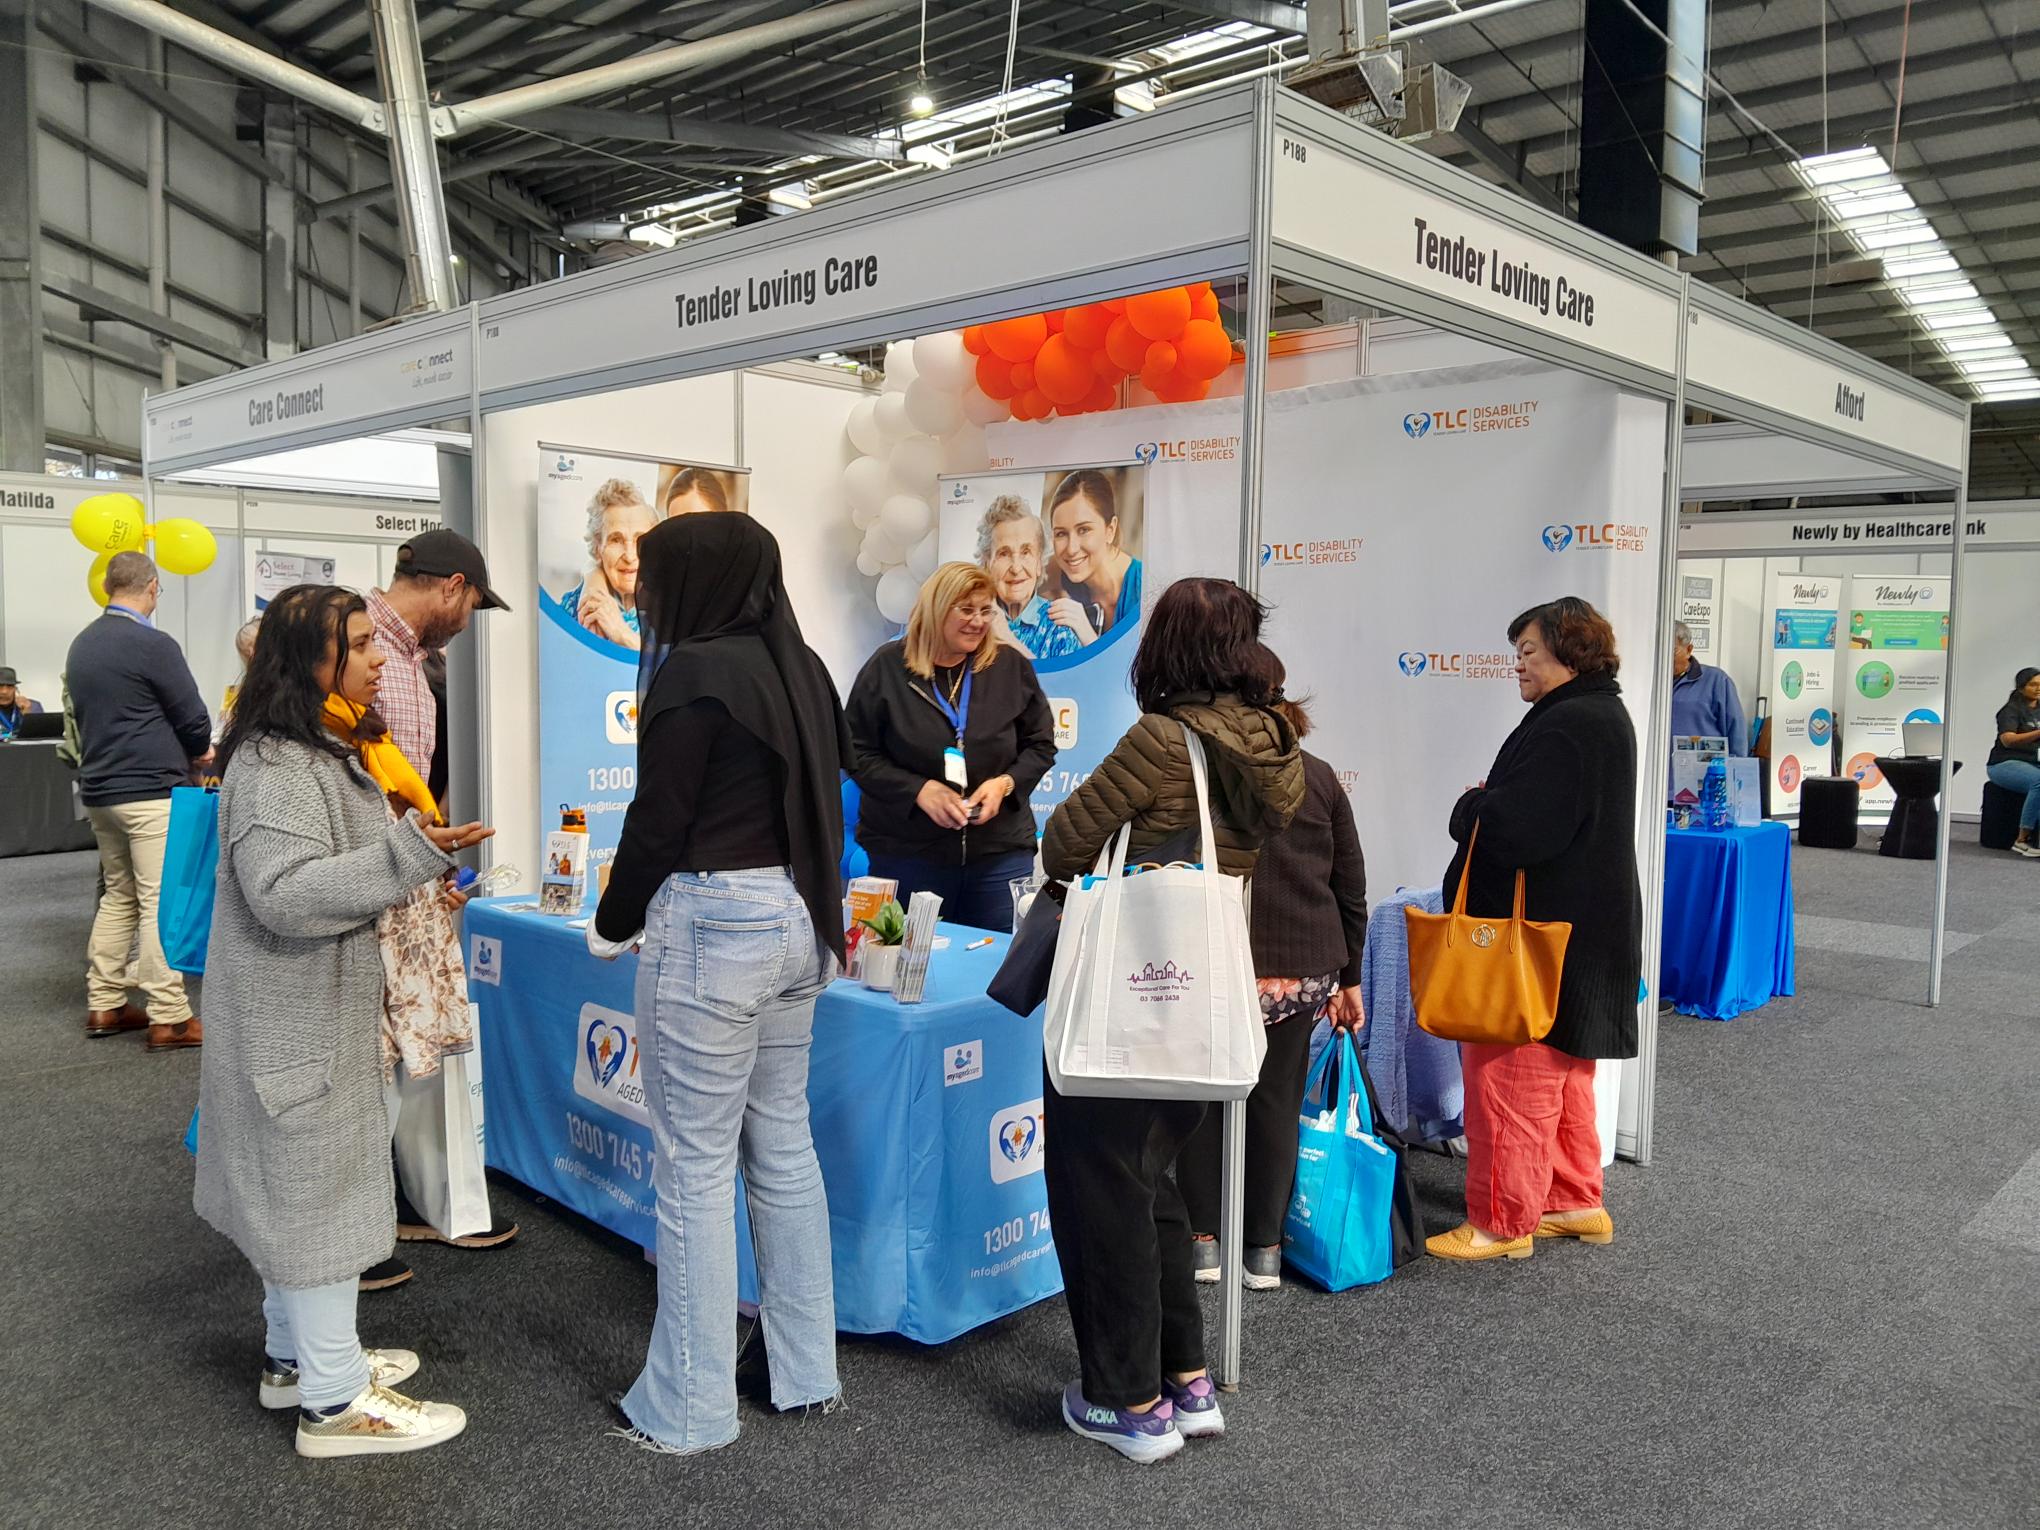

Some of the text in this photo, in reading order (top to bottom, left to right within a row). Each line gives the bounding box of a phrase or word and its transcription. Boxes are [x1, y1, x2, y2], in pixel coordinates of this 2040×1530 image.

[1283, 138, 1306, 163] P188
[1414, 217, 1594, 326] Tender Loving Care
[675, 255, 878, 328] Tender Loving Care
[248, 383, 324, 427] Care Connect
[1473, 400, 1539, 419] DISABILITY
[1835, 382, 1865, 422] Afford
[1433, 409, 1467, 429] TLC
[1473, 415, 1530, 432] SERVICES
[1159, 441, 1186, 457] TLC
[1190, 437, 1240, 450] DISABILITY
[1190, 449, 1234, 462] SERVICES
[376, 515, 416, 531] Select
[1792, 524, 1839, 541] Newly
[1843, 523, 1861, 541] by
[105, 519, 124, 549] Care
[1574, 524, 1614, 544] TLC
[1272, 543, 1303, 560] TLC
[1309, 538, 1363, 552] DISABILITY
[1309, 551, 1356, 564] SERVICES
[1793, 583, 1820, 604] Newly
[1875, 584, 1919, 605] Newly
[1428, 654, 1460, 671] TLC
[1466, 654, 1517, 665] DISABILI
[587, 766, 634, 791] 1300
[617, 1082, 643, 1104] AGED
[566, 1111, 604, 1161] 1300
[608, 1133, 642, 1181] 745
[983, 1217, 1024, 1255] 1300
[1085, 1408, 1118, 1424] HOKA
